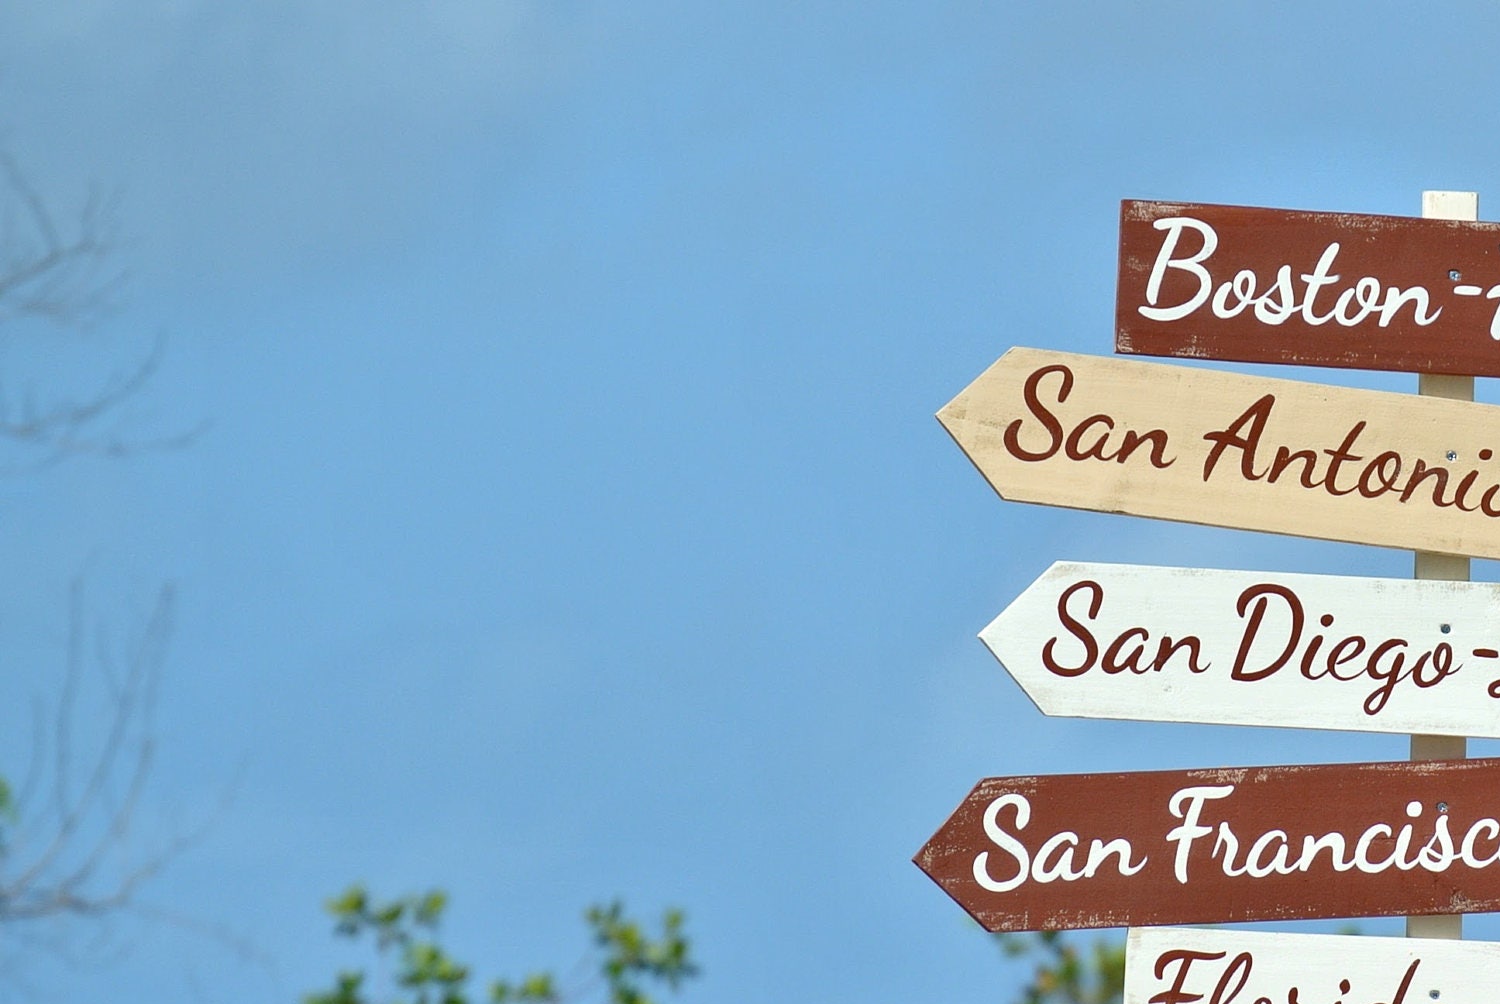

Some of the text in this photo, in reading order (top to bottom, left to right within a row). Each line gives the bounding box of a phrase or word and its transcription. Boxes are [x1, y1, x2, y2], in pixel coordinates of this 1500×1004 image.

[1004, 364, 1177, 468] San
[1043, 580, 1210, 677] San
[973, 794, 1145, 892] San
